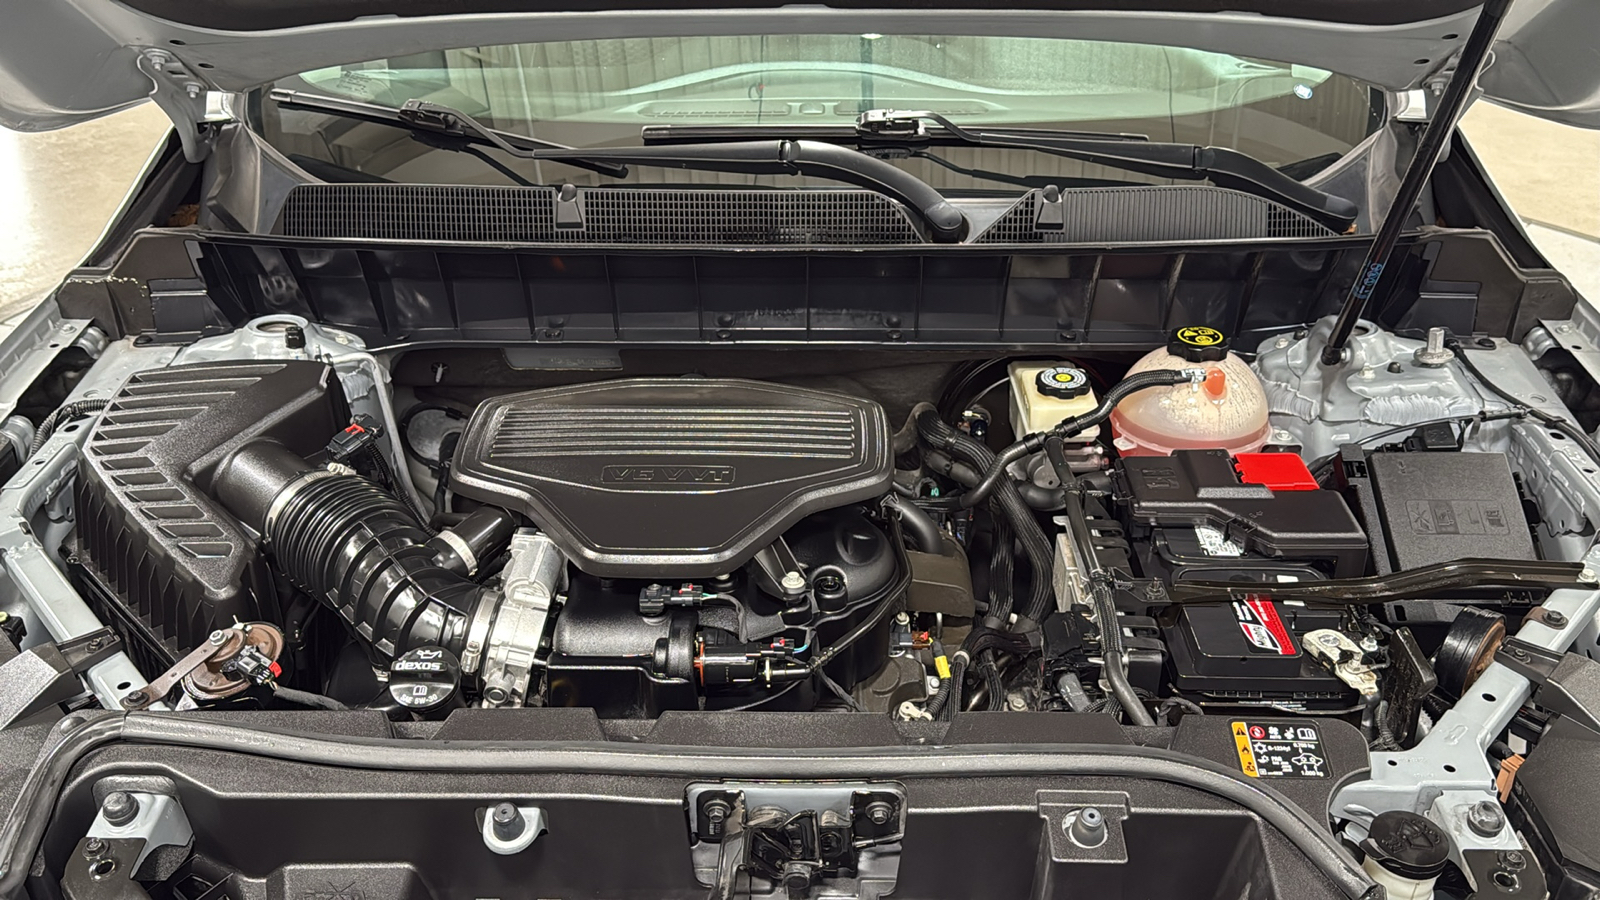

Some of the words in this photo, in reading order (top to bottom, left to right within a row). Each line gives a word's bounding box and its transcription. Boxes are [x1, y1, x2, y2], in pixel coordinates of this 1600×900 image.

[608, 468, 655, 480] V6
[661, 468, 730, 480] VVT
[395, 660, 442, 670] dexos
[400, 694, 413, 704] SAE
[414, 694, 438, 705] 5W-30
